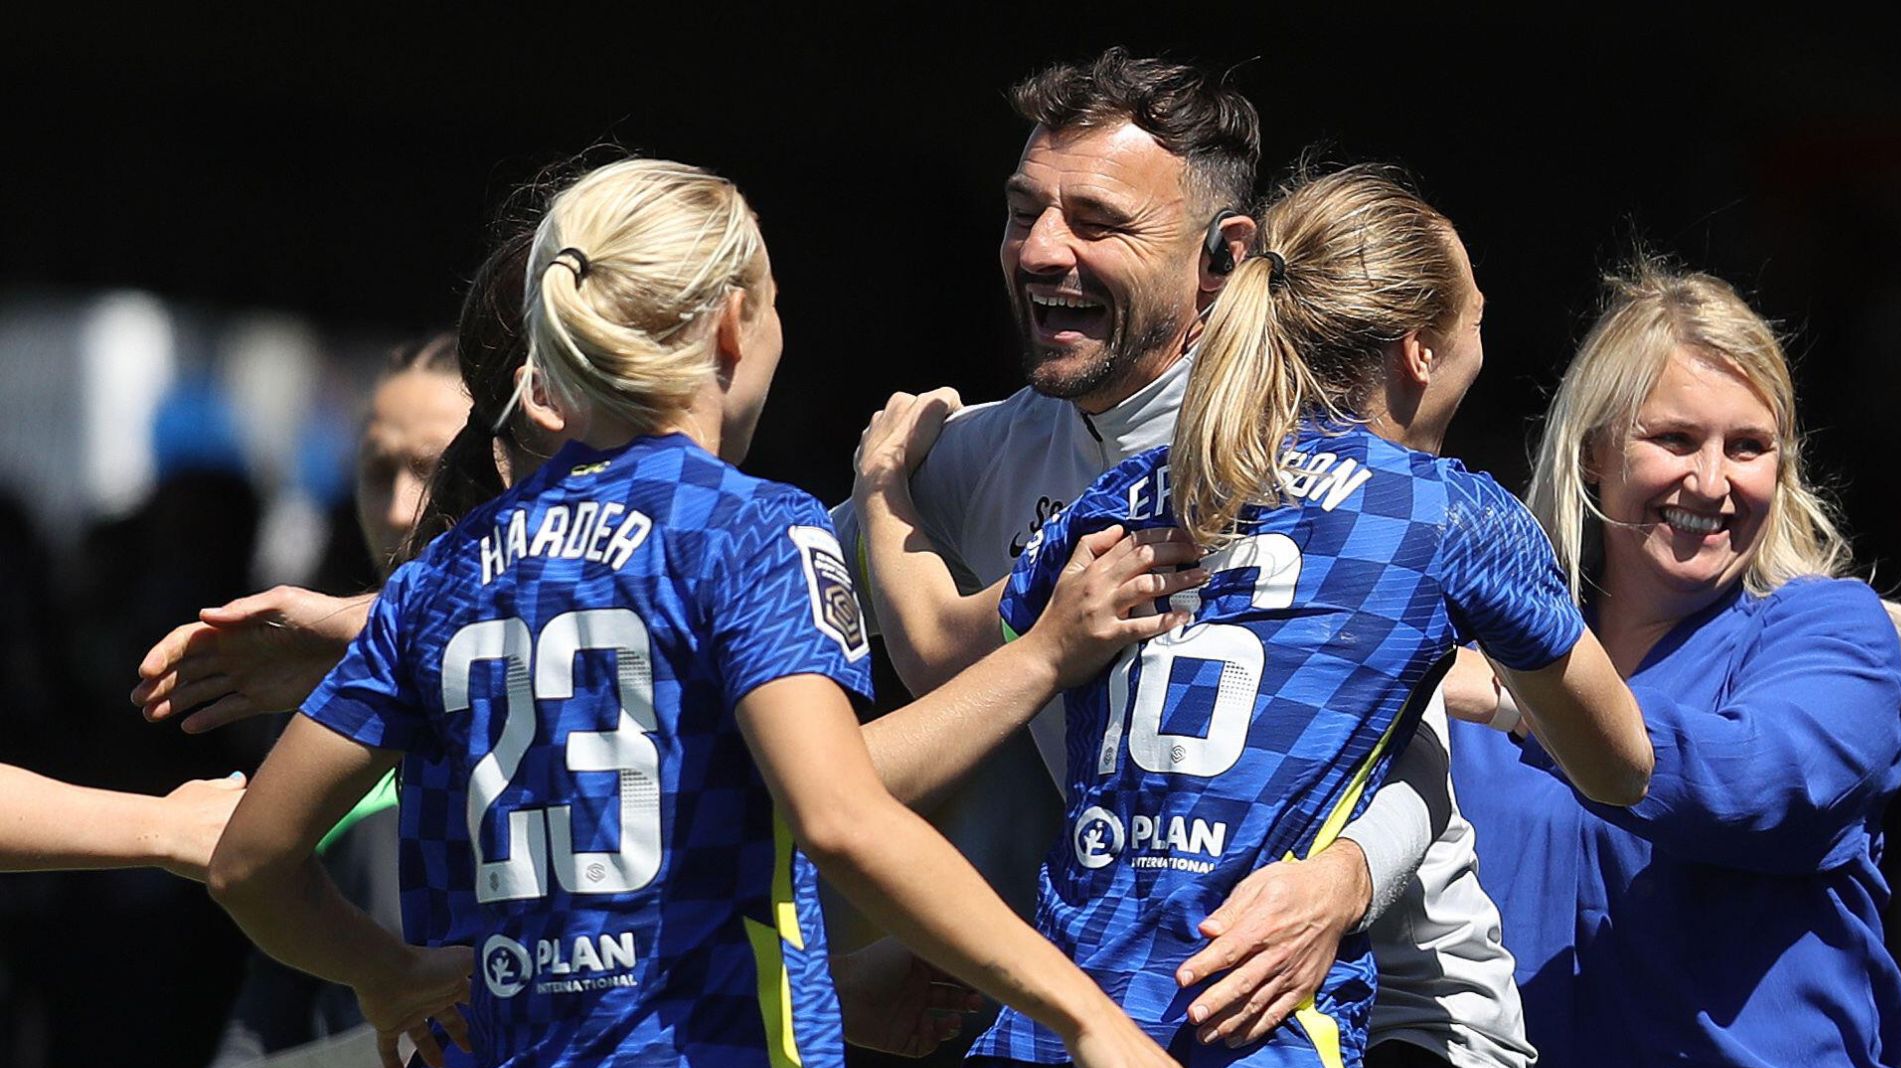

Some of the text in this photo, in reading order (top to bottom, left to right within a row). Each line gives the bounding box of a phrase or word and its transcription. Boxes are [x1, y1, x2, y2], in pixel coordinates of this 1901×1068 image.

[480, 501, 653, 585] HARDER
[441, 607, 662, 903] 23
[1131, 816, 1226, 857] PLAN
[536, 932, 636, 975] PLAN
